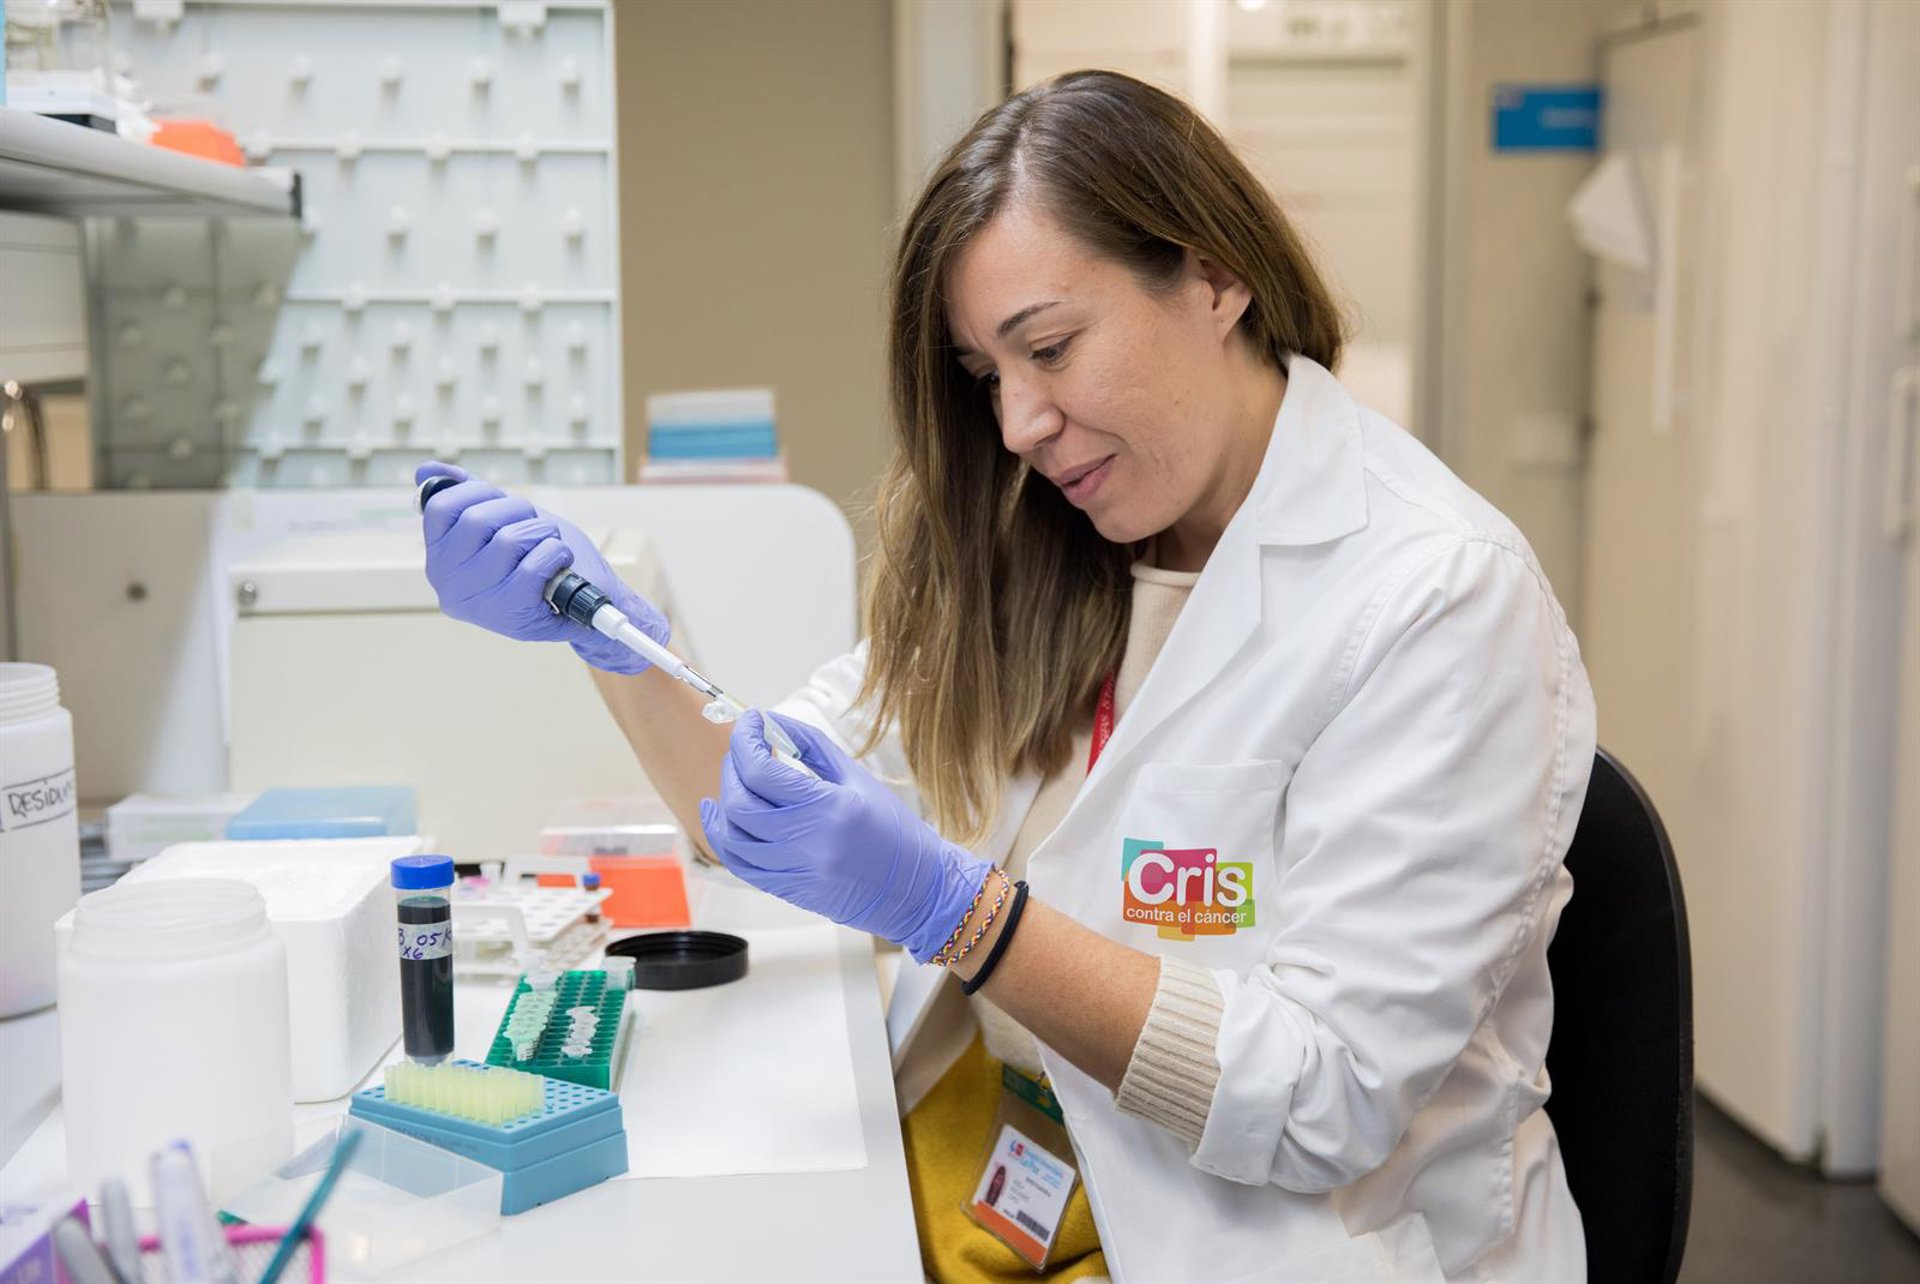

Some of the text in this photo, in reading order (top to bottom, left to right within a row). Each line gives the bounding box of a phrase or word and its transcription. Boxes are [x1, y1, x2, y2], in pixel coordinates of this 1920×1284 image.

[1128, 852, 1247, 907] Cris
[1126, 907, 1247, 924] contra el cáncer
